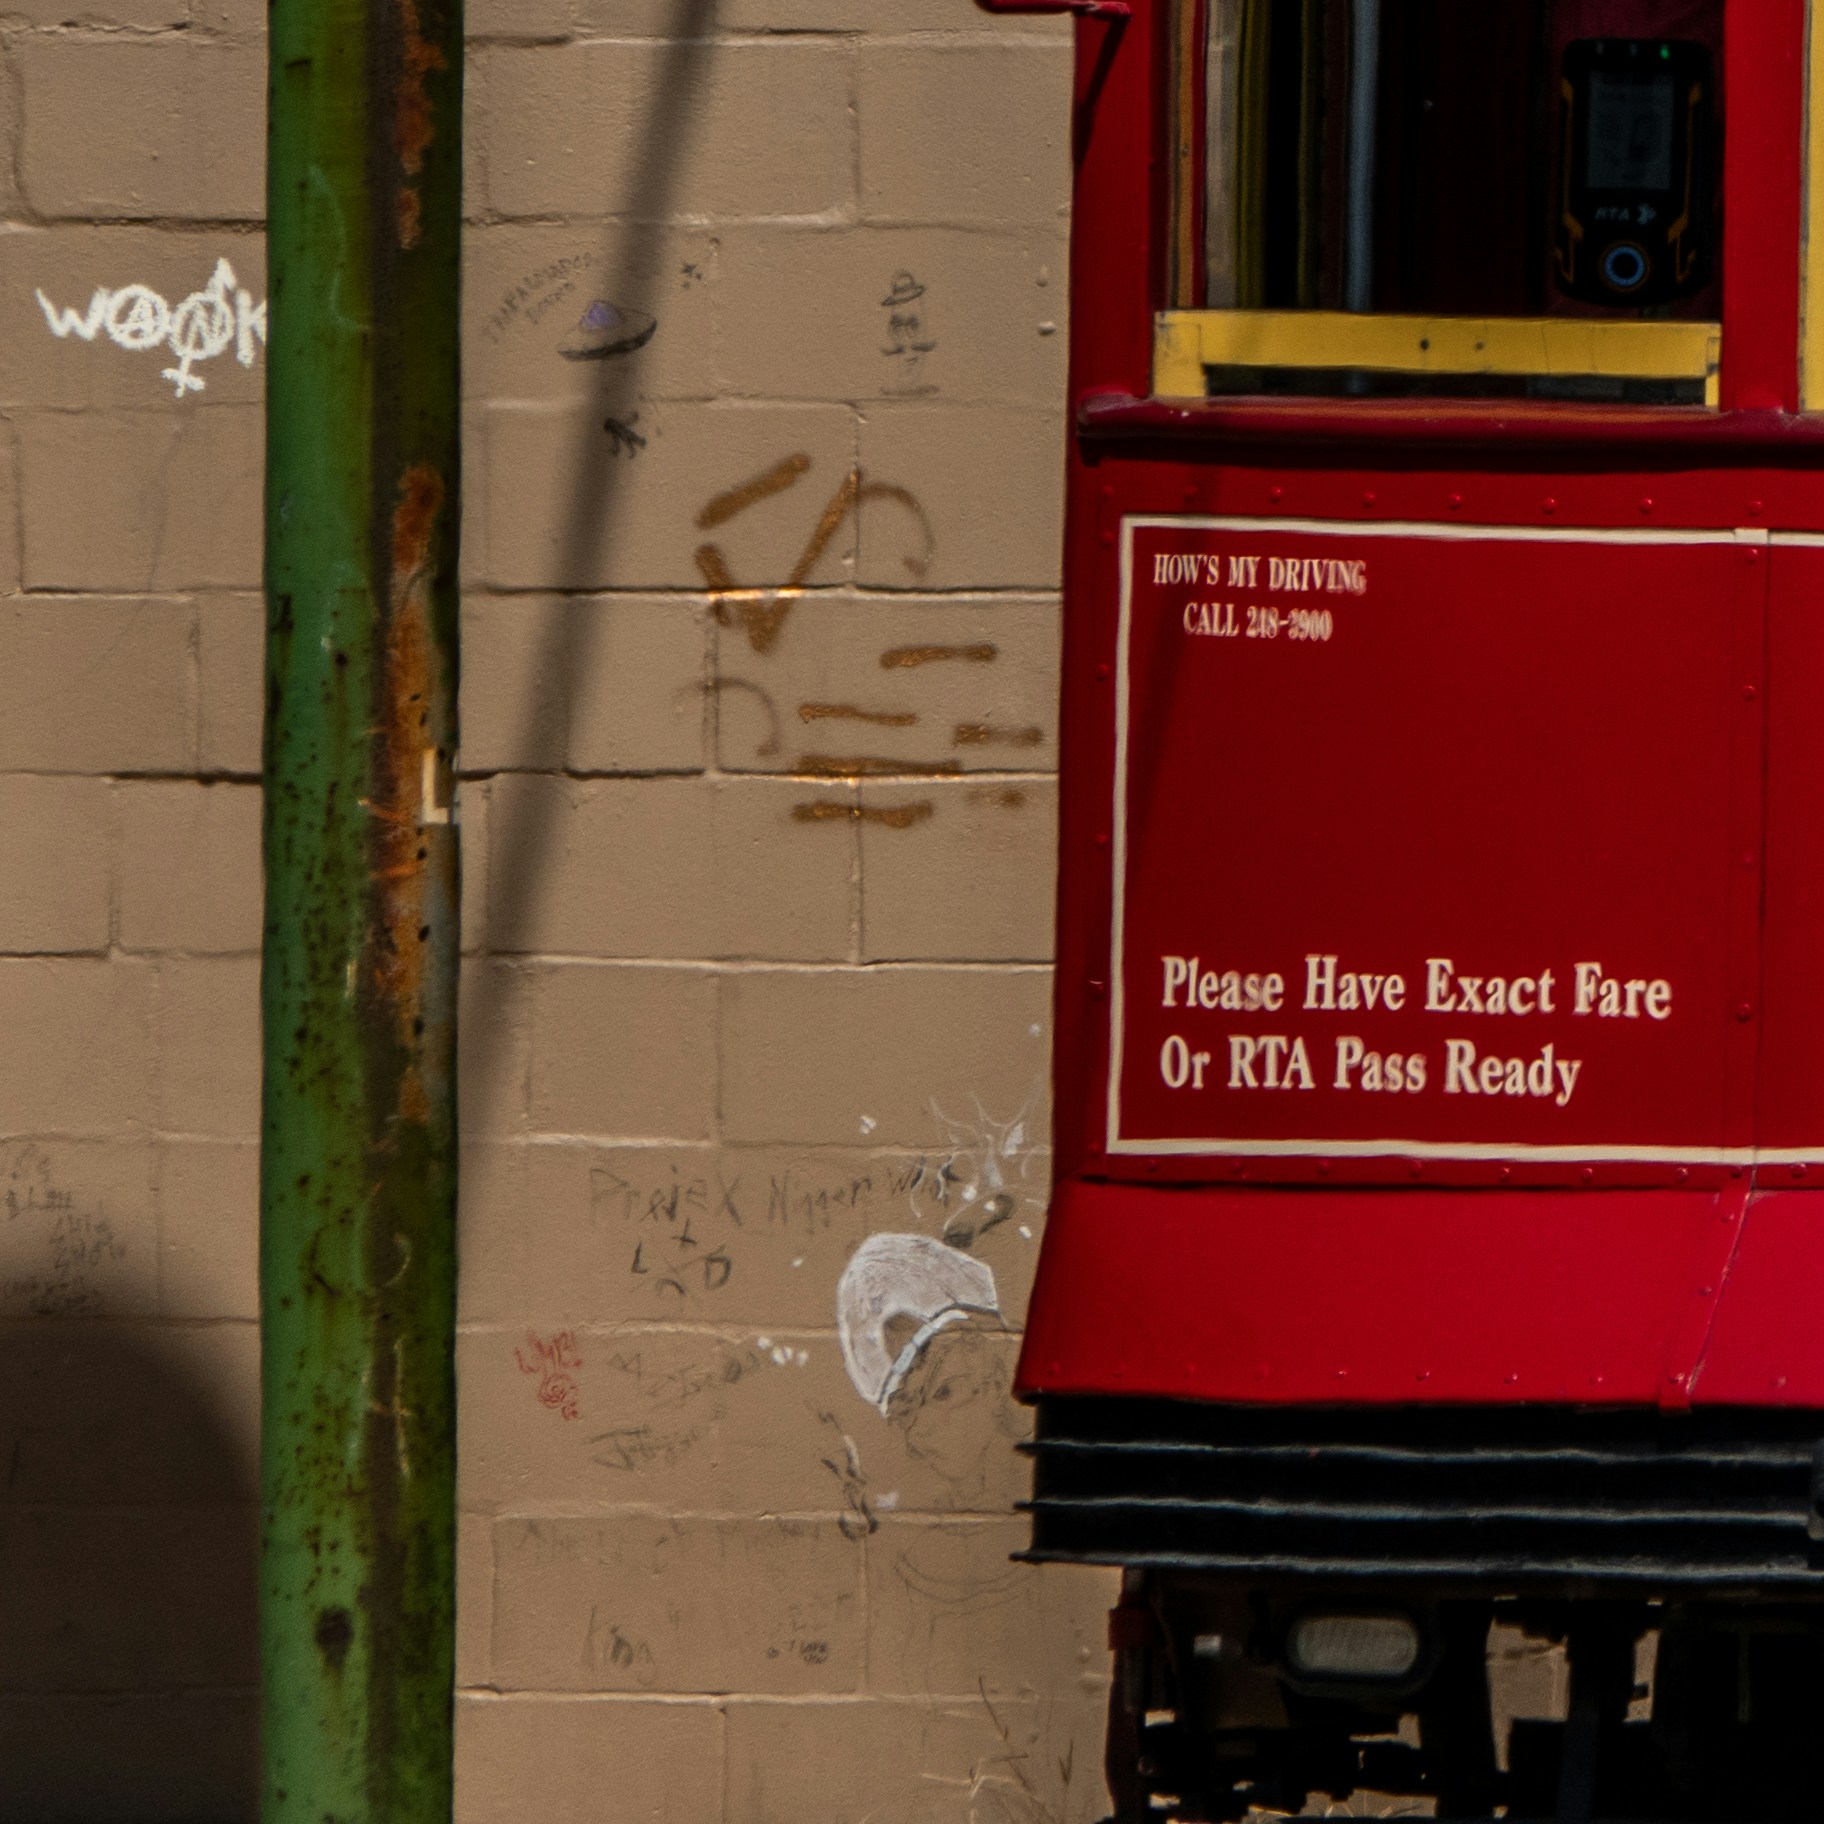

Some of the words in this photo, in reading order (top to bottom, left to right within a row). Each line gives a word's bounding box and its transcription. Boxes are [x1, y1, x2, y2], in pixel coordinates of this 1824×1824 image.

[1153, 554, 1219, 585] HOW'S
[1227, 556, 1261, 587] MY
[1268, 557, 1367, 596] DRIVING
[1183, 602, 1240, 637] CALL
[1160, 956, 1284, 1012] Please
[1302, 954, 1405, 1011] Have
[1424, 958, 1556, 1016] Exact
[1573, 962, 1672, 1019] Fare
[1160, 1034, 1211, 1089] Or
[1227, 1035, 1316, 1090] RTA
[1332, 1036, 1427, 1094] Pass
[1444, 1038, 1583, 1106] Ready
